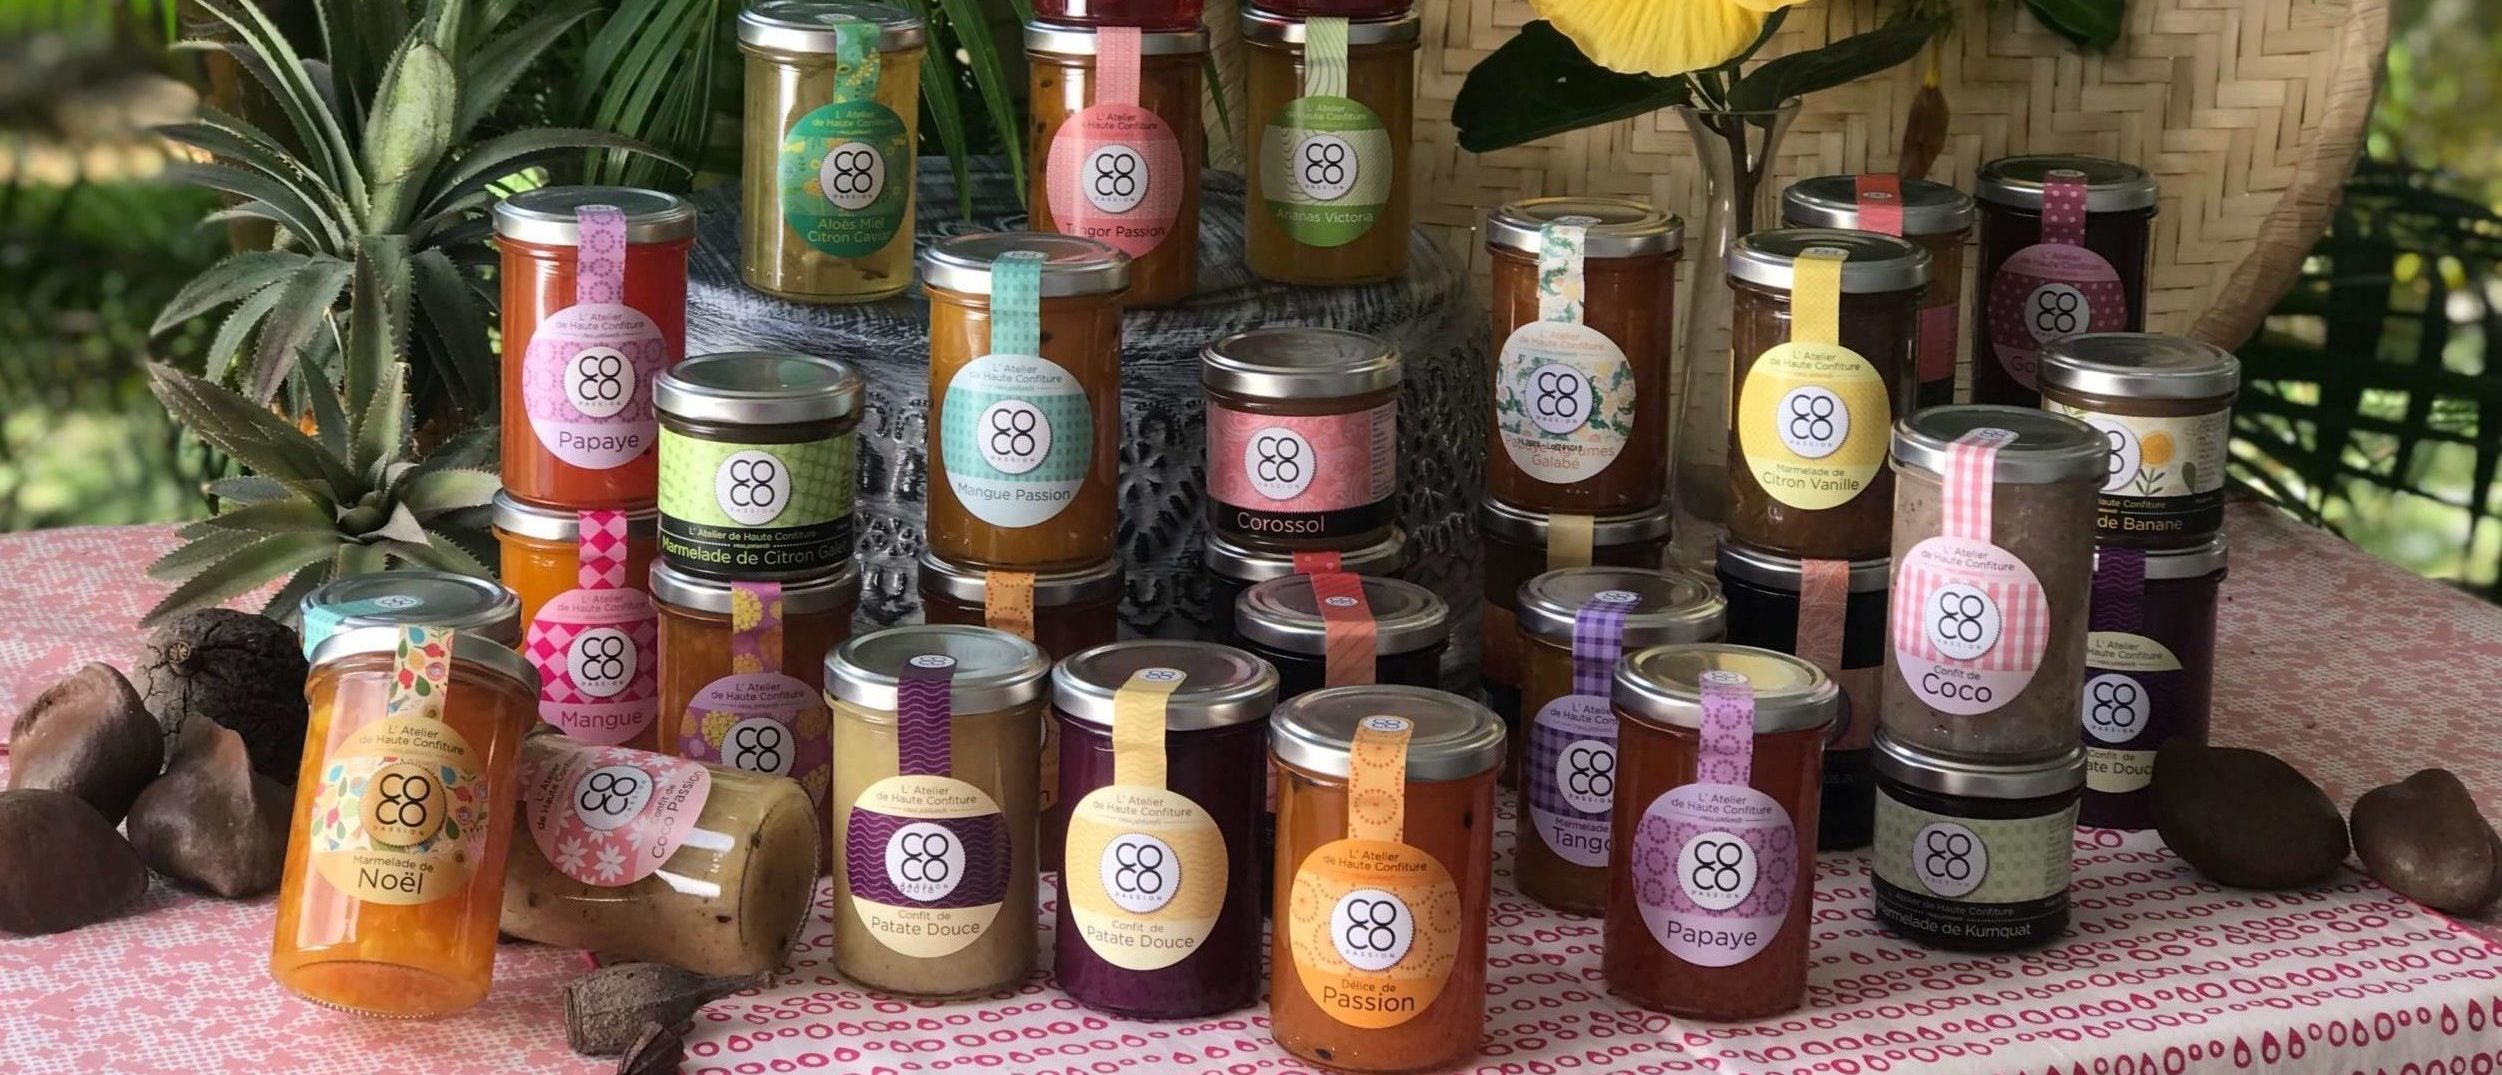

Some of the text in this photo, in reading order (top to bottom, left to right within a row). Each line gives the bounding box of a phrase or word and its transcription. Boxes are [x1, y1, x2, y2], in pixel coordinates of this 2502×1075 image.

[808, 231, 849, 242] Citron
[1066, 223, 1165, 238] Tngor Passion
[560, 431, 639, 452] Papaye
[1777, 463, 1844, 476] Marmelade de
[1763, 472, 1859, 491] Citron Vanille
[958, 482, 1071, 501] Mangue Passion
[1237, 512, 1325, 532] Corossol
[2097, 515, 2183, 531] de Banane
[729, 532, 740, 541] de
[744, 533, 772, 541] Haute
[663, 535, 731, 563] Marmelade
[736, 551, 759, 565] de
[764, 549, 813, 565] Citron
[1934, 665, 1980, 681] Confit de
[1923, 673, 1992, 702] Coco
[561, 711, 642, 729] Mangue
[402, 726, 439, 739] Atelier
[2087, 761, 2152, 775] ate Douc
[667, 770, 704, 812] Passion
[1712, 793, 1747, 804] Atelier
[1128, 796, 1164, 807] Atelier
[1672, 799, 1772, 815] de Haute Confiture
[1555, 817, 1609, 833] Marmelade
[1553, 826, 1611, 853] Tango
[354, 855, 433, 873] Marmelade de
[1362, 851, 1399, 862] Atelier
[358, 868, 423, 895] Noël
[898, 910, 950, 920] Confit de
[872, 916, 980, 936] Patate Douce
[1112, 920, 1164, 933] Confit de
[1942, 923, 1961, 935] de
[1965, 923, 2031, 938] Kumquat
[1087, 926, 1194, 948] Patate Douce
[1667, 920, 1757, 950] Papaye
[1342, 979, 1396, 992] Délice de
[1323, 986, 1415, 1012] Passion
